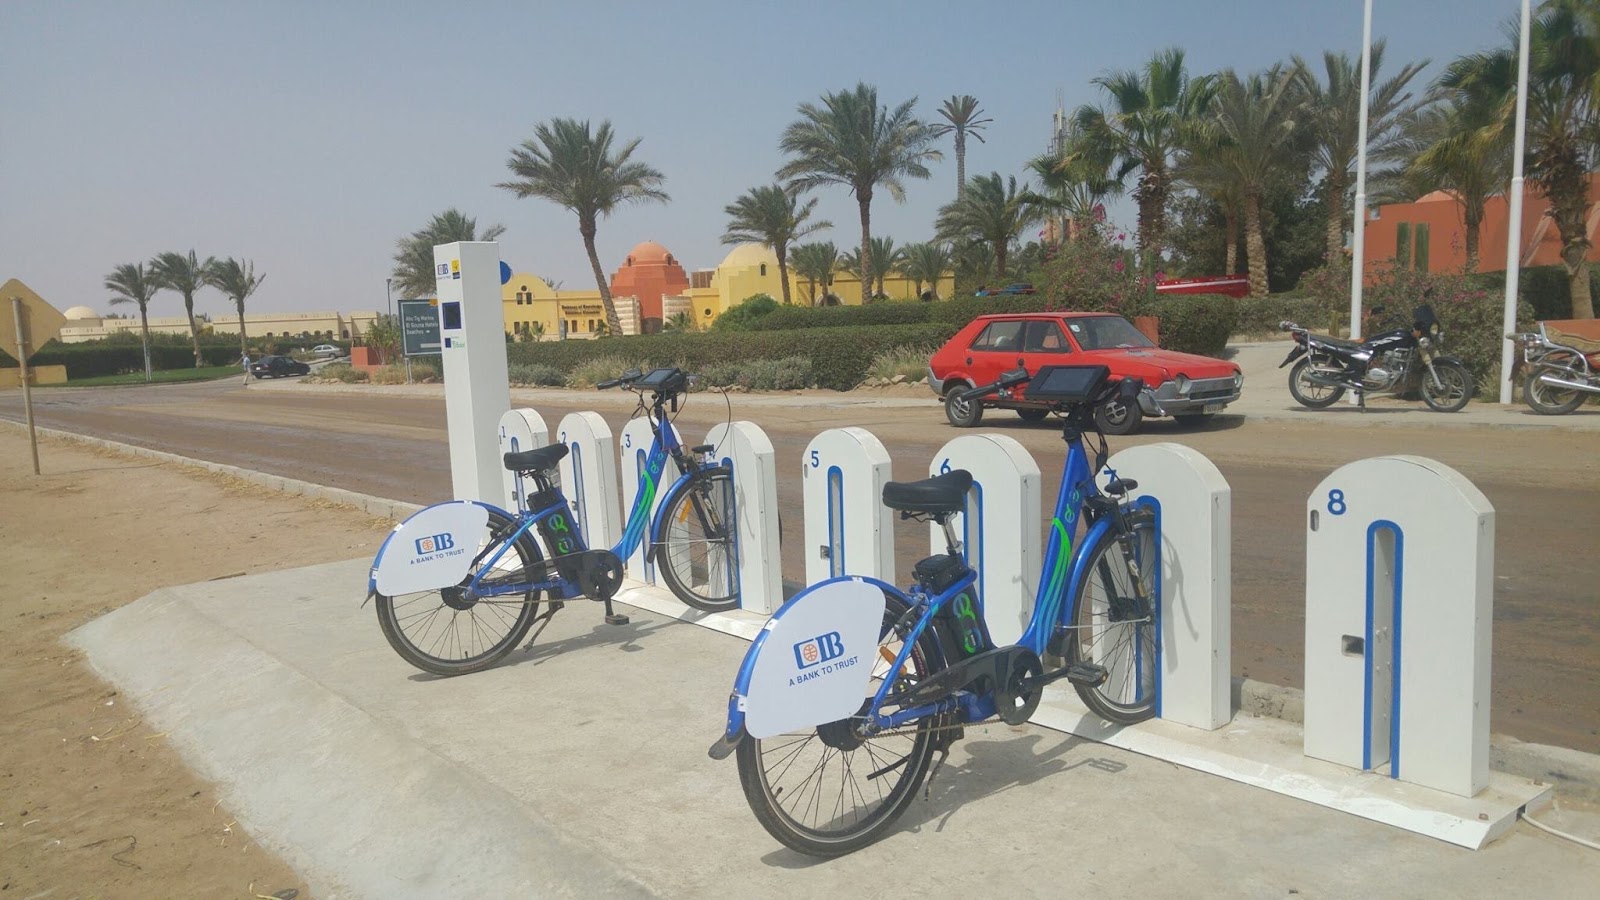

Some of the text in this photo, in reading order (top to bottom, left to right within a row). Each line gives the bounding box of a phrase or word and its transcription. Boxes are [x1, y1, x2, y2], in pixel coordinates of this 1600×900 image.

[501, 425, 506, 438] 1
[561, 431, 567, 445] 2
[625, 434, 631, 448] 3
[811, 450, 819, 468] 5
[1327, 488, 1347, 516] 8
[415, 532, 455, 555] CIB
[416, 555, 434, 564] BANK
[445, 548, 465, 557] TRUST
[793, 631, 845, 670] CIB
[789, 656, 859, 687] A BANK TO TRUST
